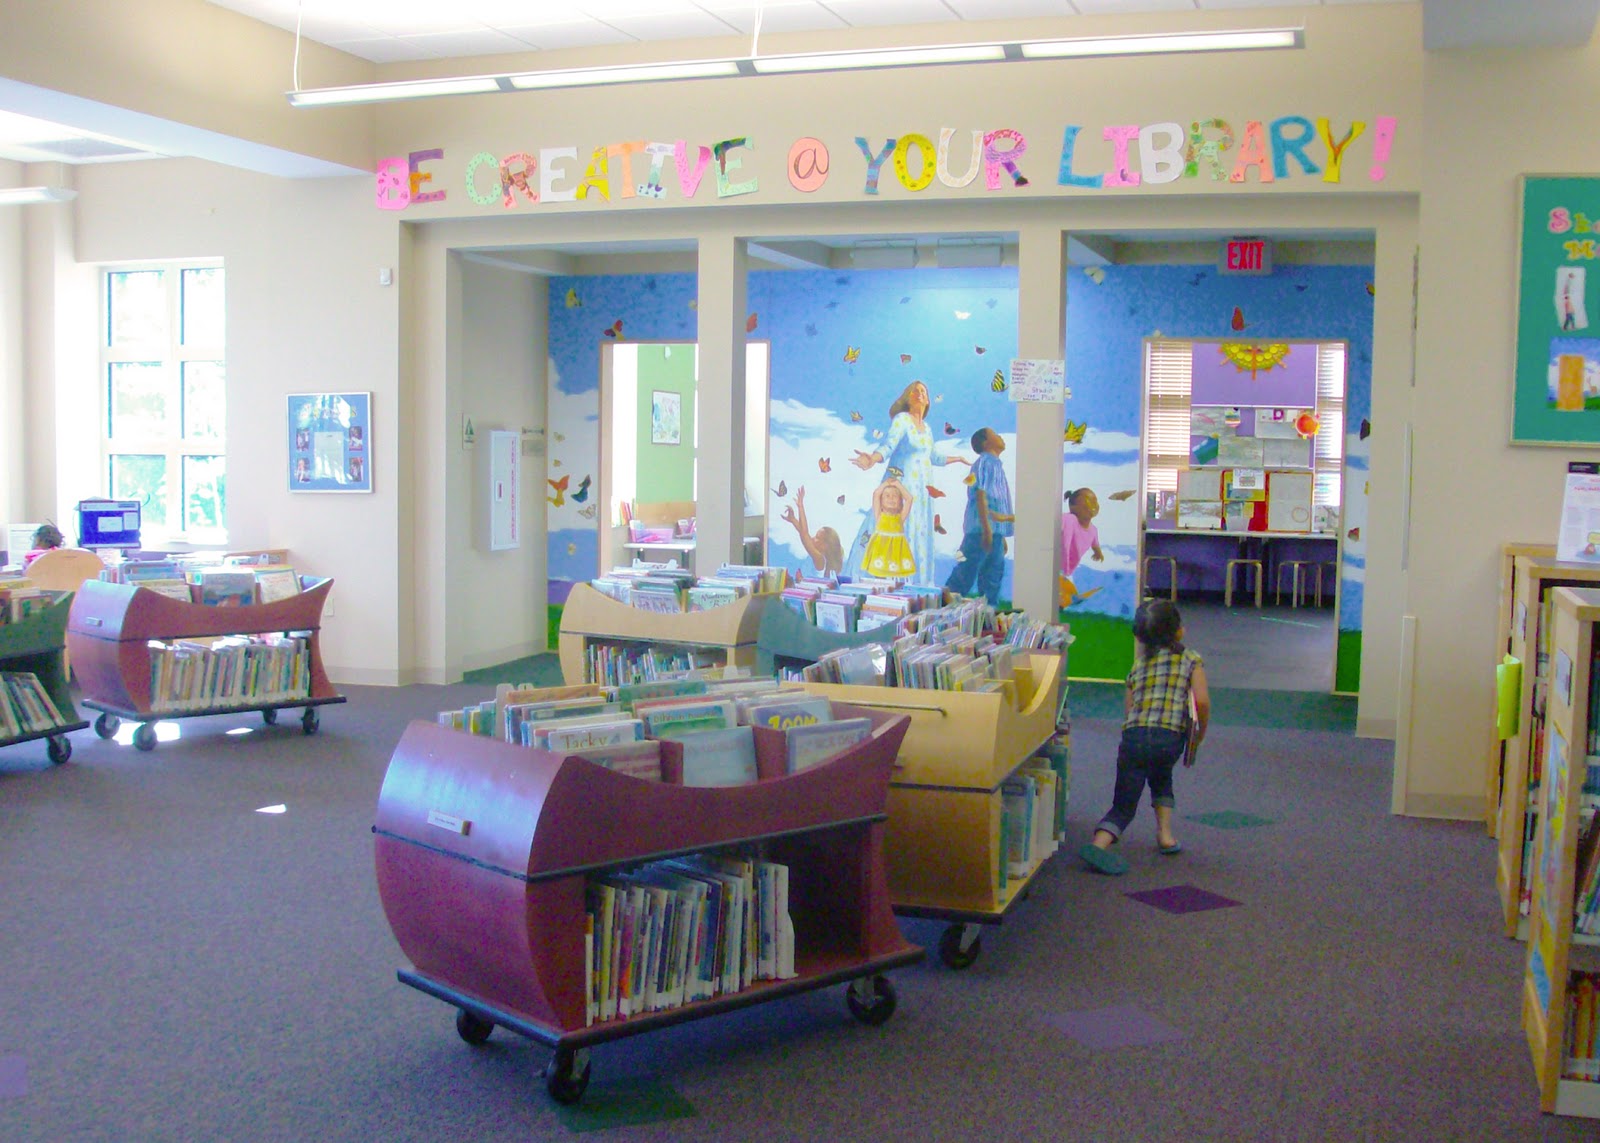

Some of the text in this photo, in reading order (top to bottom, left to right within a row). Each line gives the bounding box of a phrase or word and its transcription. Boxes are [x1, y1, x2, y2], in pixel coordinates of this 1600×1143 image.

[376, 148, 447, 211] BE
[465, 137, 759, 206] CREATIVE
[794, 142, 830, 180] @
[854, 127, 1028, 194] YOUR
[1227, 240, 1264, 270] EXIT
